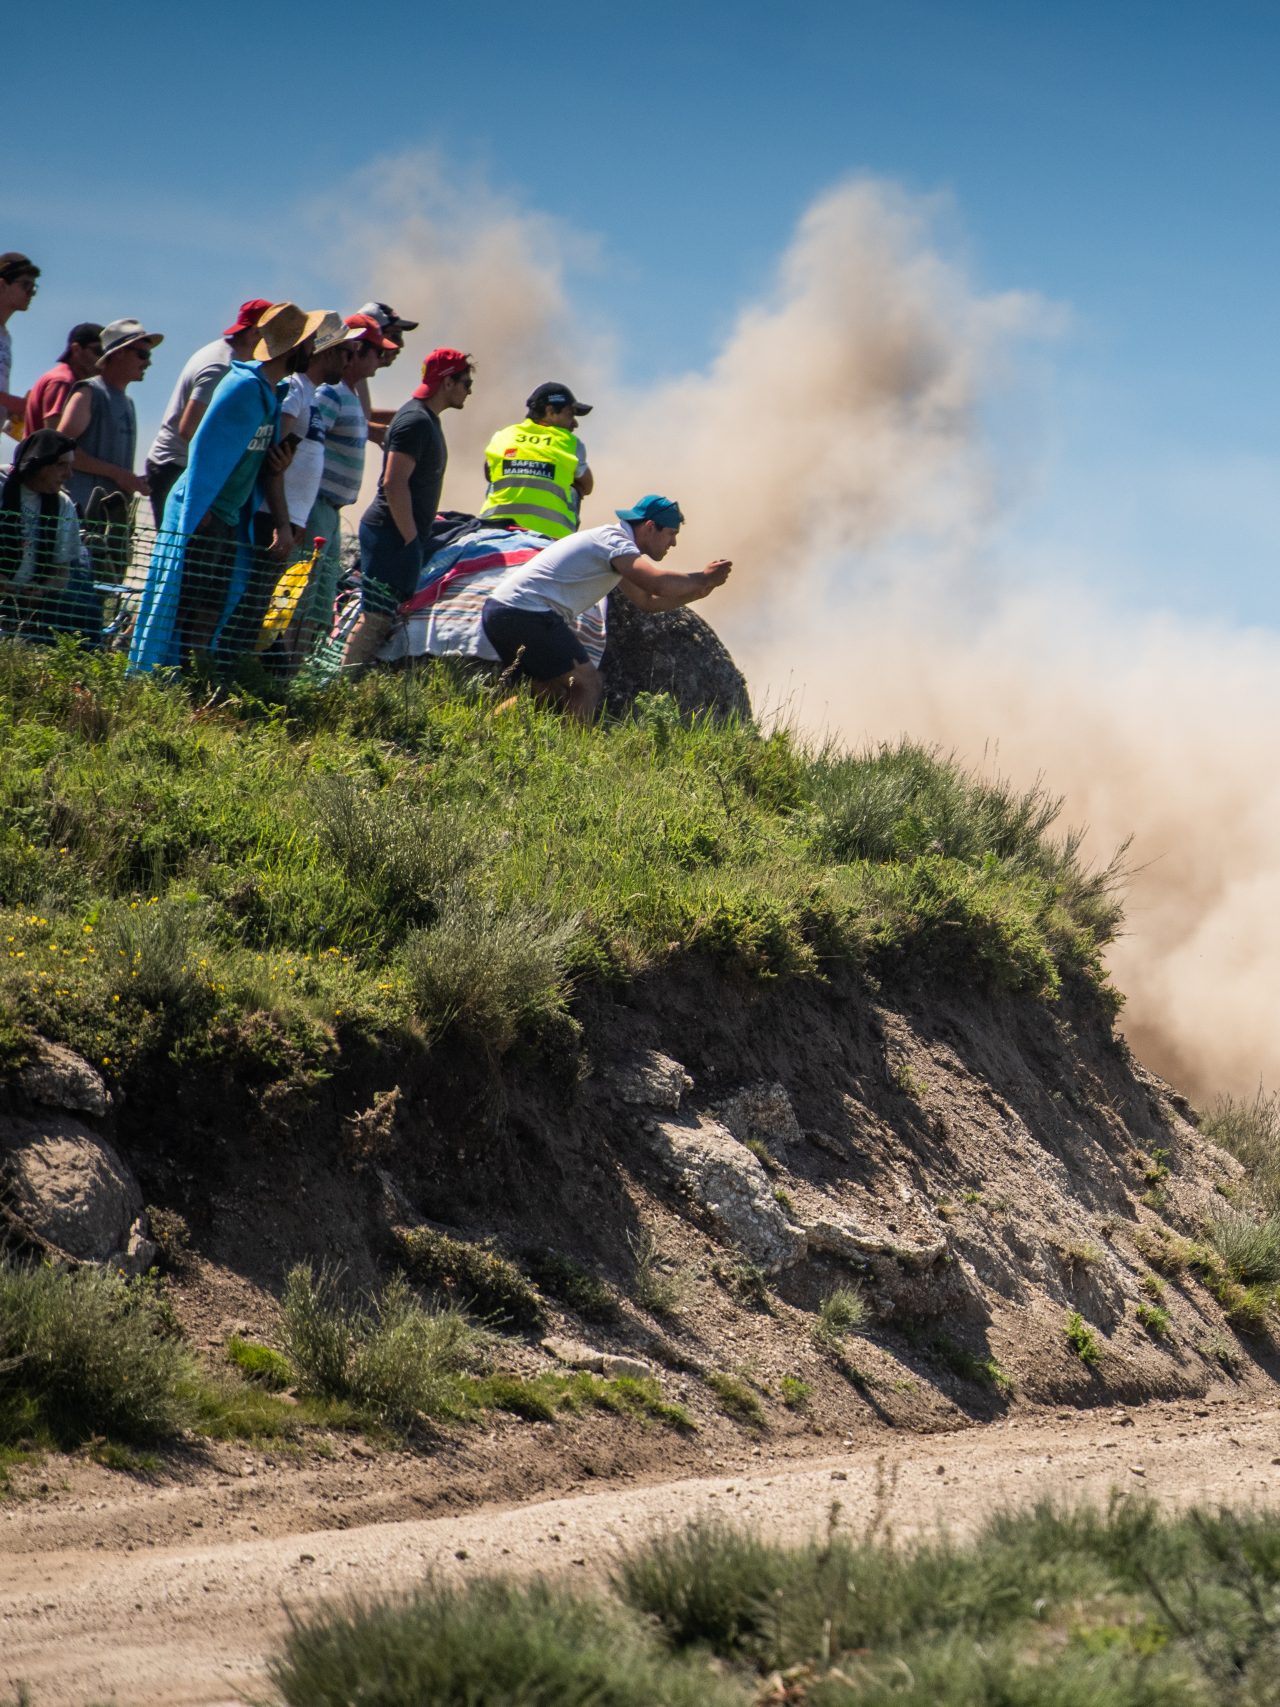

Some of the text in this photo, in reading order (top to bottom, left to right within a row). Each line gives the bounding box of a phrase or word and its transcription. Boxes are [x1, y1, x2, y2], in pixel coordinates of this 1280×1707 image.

[515, 434, 553, 446] 301
[510, 460, 547, 468] SAFETY
[503, 468, 553, 479] MARSHALL
